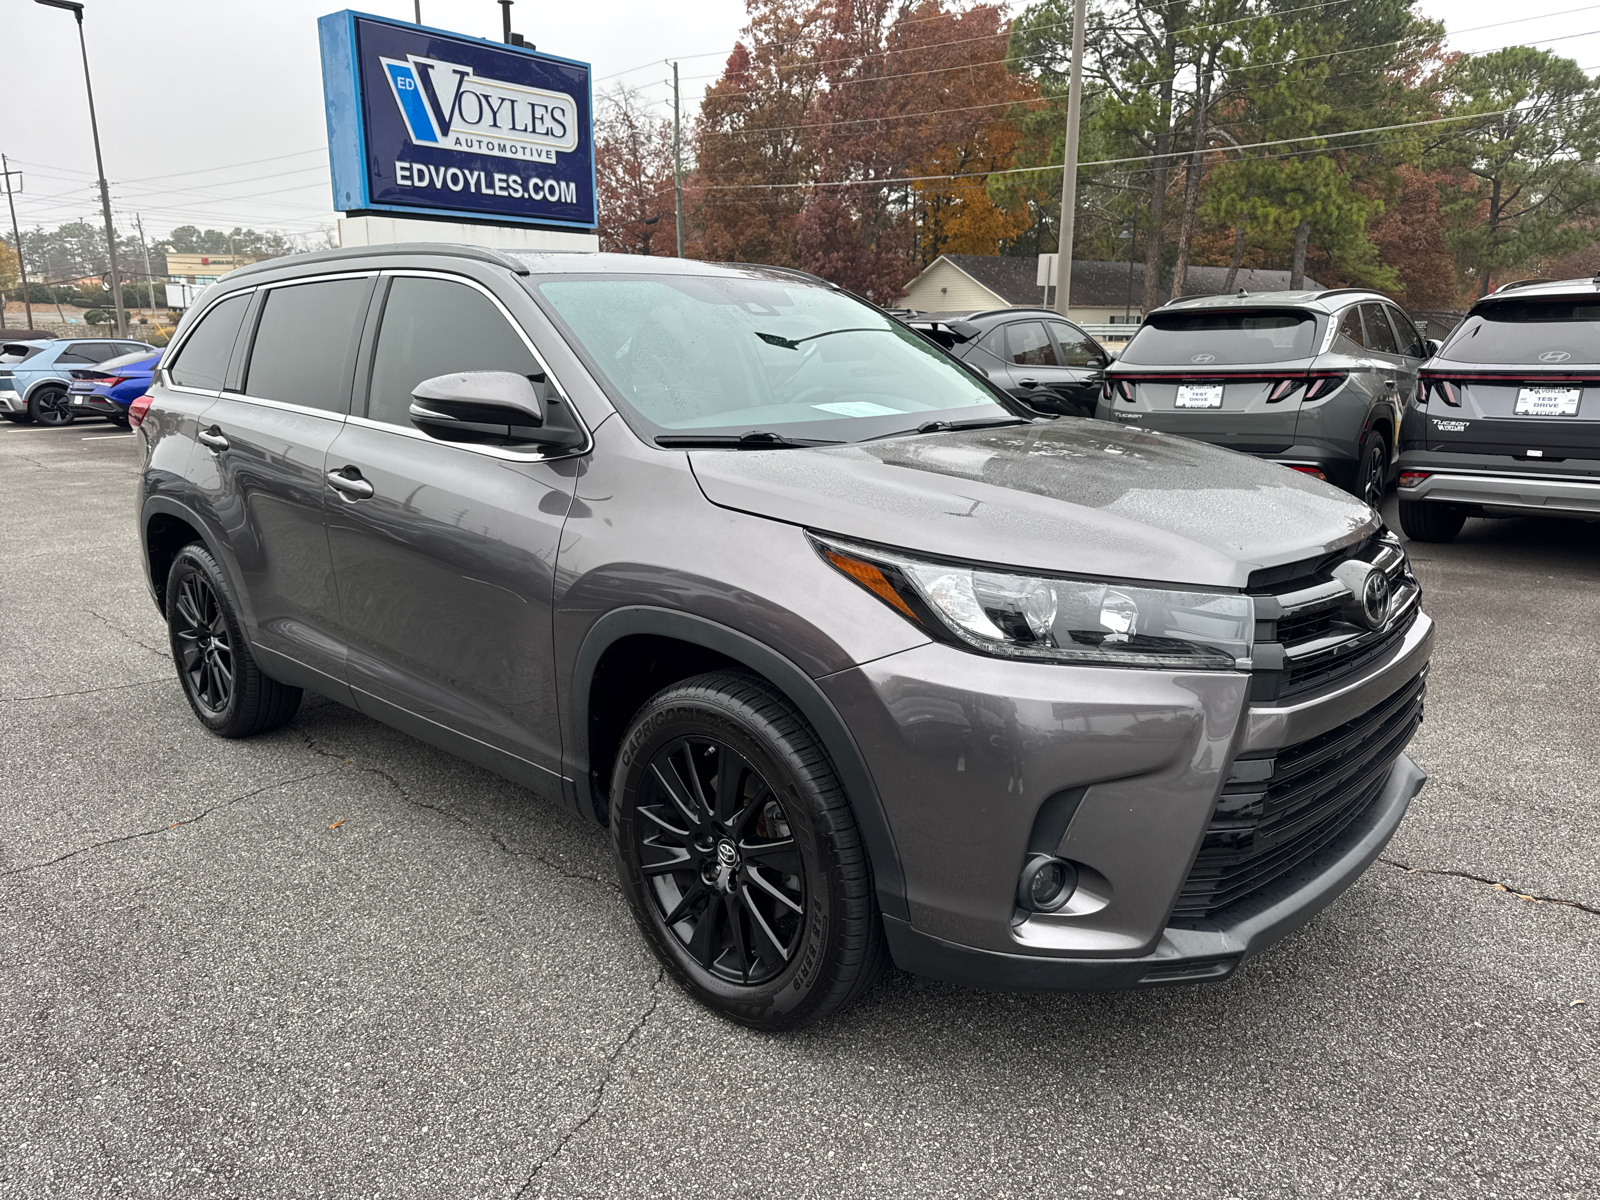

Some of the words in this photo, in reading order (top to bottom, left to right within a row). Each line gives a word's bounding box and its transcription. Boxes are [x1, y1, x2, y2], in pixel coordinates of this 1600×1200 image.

[397, 76, 415, 91] ED
[412, 60, 568, 139] VOYLES
[454, 136, 553, 160] AUTOMOTIVE
[394, 161, 577, 204] EDVOYLES.COM
[622, 705, 702, 768] CAPRICORN
